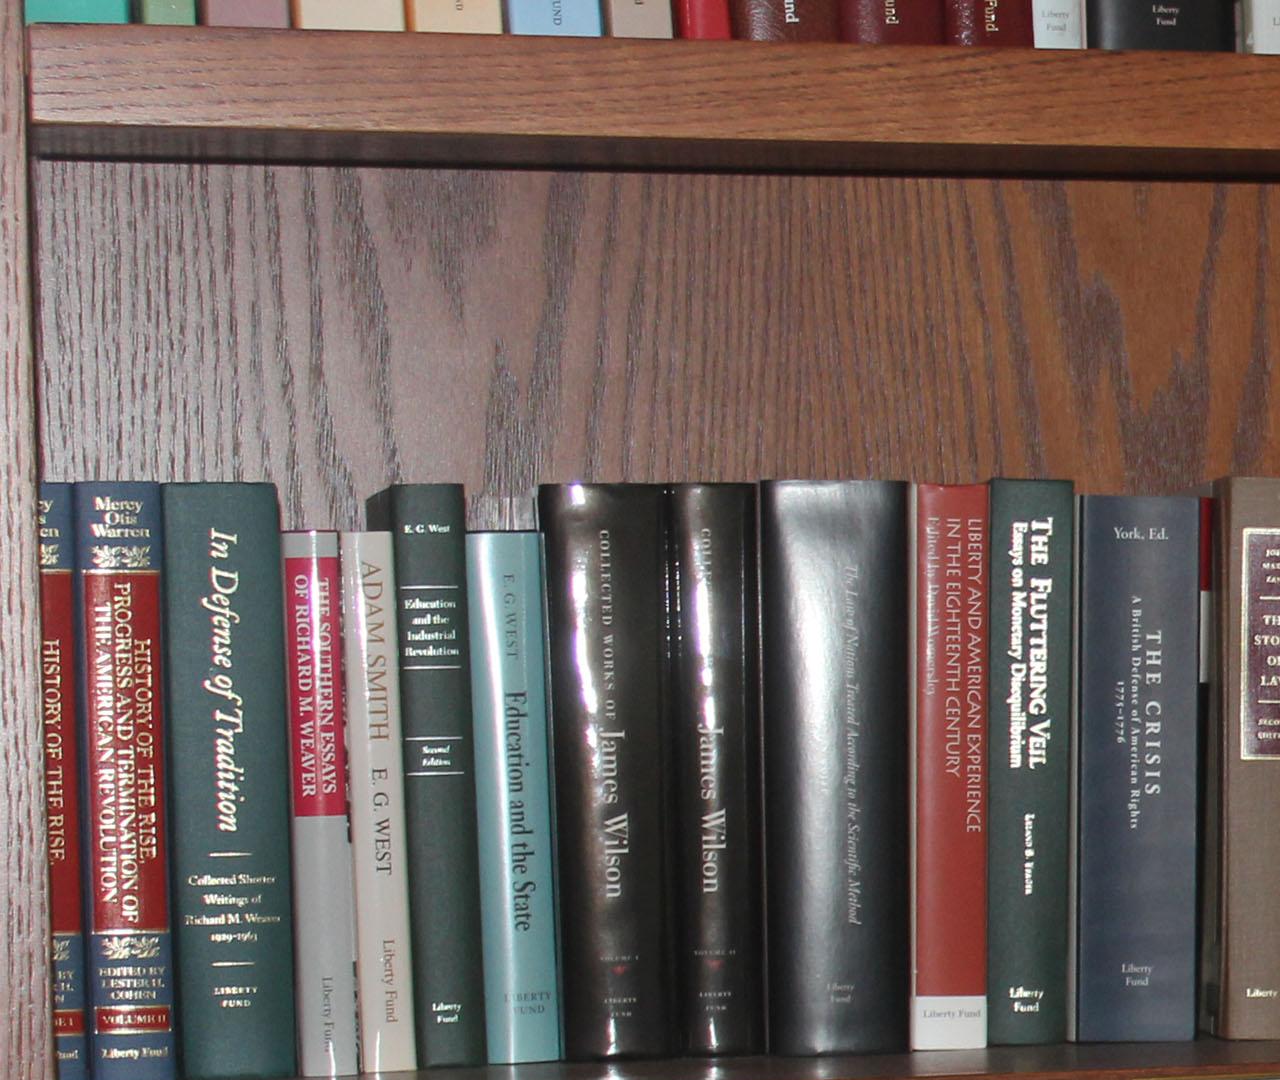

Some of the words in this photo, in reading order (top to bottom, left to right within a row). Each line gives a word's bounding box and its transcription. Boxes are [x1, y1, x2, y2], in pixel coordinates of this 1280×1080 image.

[91, 523, 150, 538] Warren
[94, 497, 143, 513] Mercy
[104, 512, 137, 524] Otis
[948, 518, 961, 538] IN
[209, 527, 237, 560] In
[947, 542, 961, 577] THE
[967, 518, 982, 584] LIBERTY
[1008, 521, 1028, 565] Essays
[294, 574, 308, 600] OF
[317, 578, 331, 616] THE
[360, 561, 384, 644] ADAM
[1011, 570, 1023, 588] on
[1132, 596, 1142, 604] A
[94, 602, 112, 648] THE
[114, 582, 132, 688] PROGRESS
[201, 566, 240, 669] Defense
[968, 590, 982, 630] AND
[1007, 591, 1027, 660] Monetary
[1131, 609, 1142, 652] British
[296, 605, 312, 691] RICHARD
[945, 581, 961, 692] EIGHTEENTH
[1145, 630, 1162, 685] THE
[134, 639, 153, 727] HISTORY
[203, 675, 243, 707] of
[318, 620, 334, 725] SOUTHERN
[367, 653, 389, 740] SMITH
[966, 634, 982, 728] AMERICAN
[1131, 657, 1142, 706] Defense
[95, 650, 115, 760] AMERICAN
[116, 692, 134, 739] AND
[299, 697, 313, 716] M.
[1006, 663, 1027, 769] Disequilibrium
[1114, 681, 1125, 744] 1775-1776
[1131, 709, 1142, 723] of
[137, 733, 153, 753] OF
[300, 720, 316, 797] WEAVER
[320, 729, 337, 794] ESSAYS
[504, 692, 529, 793] Education
[945, 696, 961, 778] CENTURY
[1130, 727, 1142, 785] American
[1144, 701, 1161, 795] CRISIS
[137, 765, 155, 807] THE
[214, 706, 245, 832] Tradition
[371, 767, 388, 786] E.
[599, 727, 625, 804] James
[966, 735, 982, 833] EXPERIENCE
[117, 747, 138, 893] TERMINATION
[372, 792, 389, 811] G.
[509, 799, 534, 835] and
[1128, 789, 1140, 829] Rights
[98, 770, 117, 903] REVOLUTION
[374, 818, 392, 874] WEST
[511, 841, 535, 874] the
[604, 812, 629, 898] Wilson
[122, 898, 138, 923] OF
[513, 882, 536, 931] State
